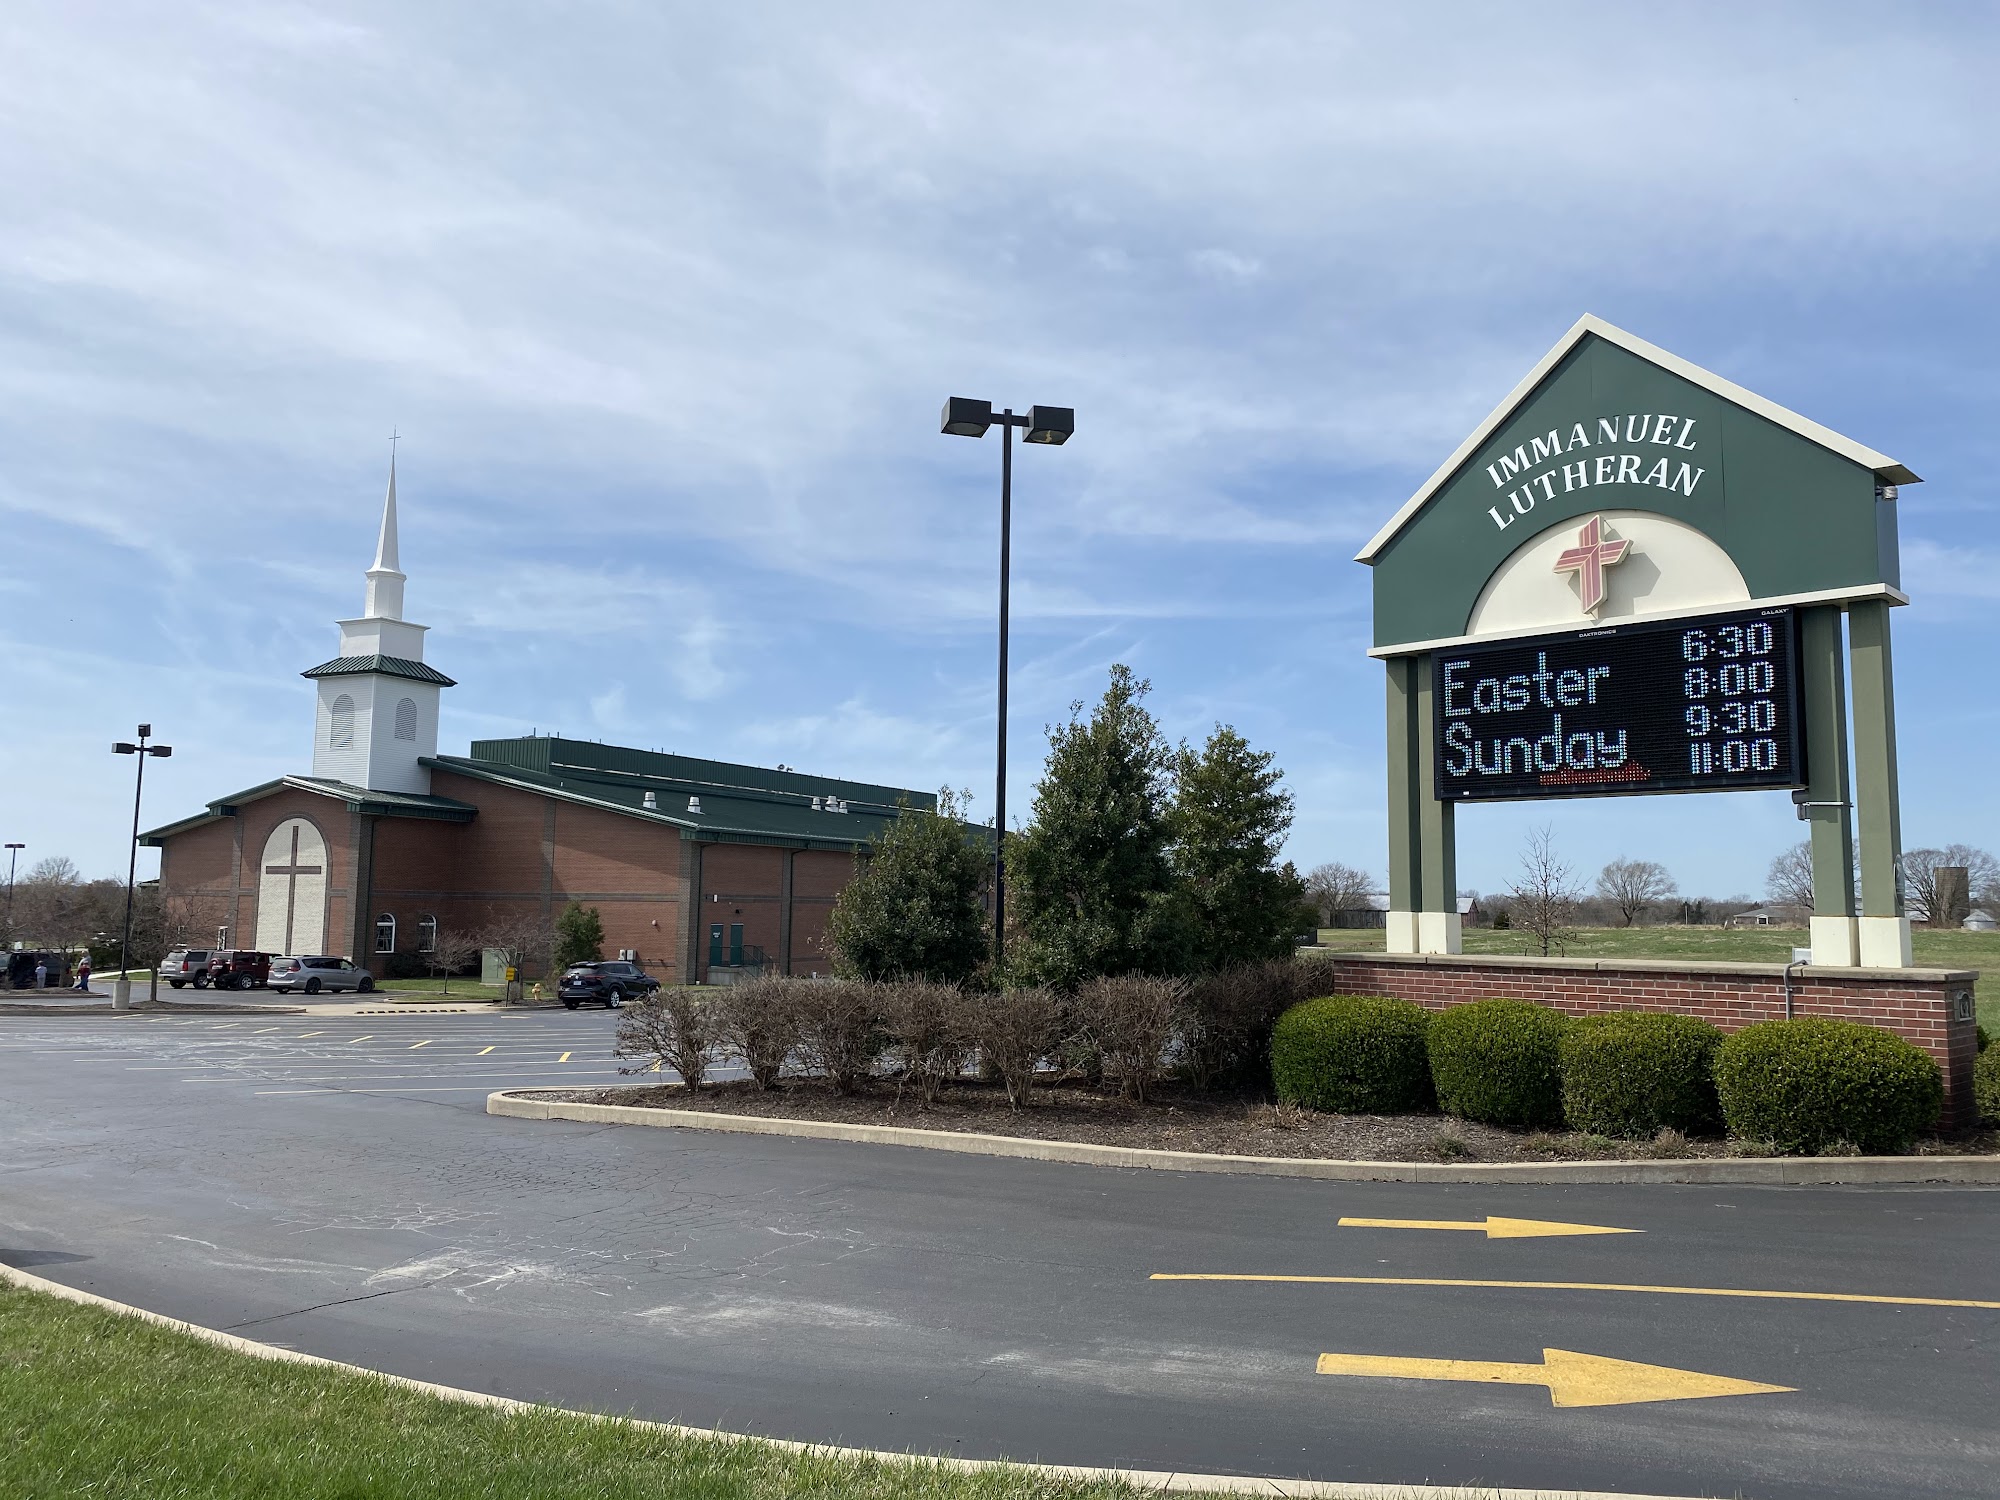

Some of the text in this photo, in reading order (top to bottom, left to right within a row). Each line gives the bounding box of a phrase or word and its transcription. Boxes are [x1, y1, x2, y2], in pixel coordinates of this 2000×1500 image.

[1486, 414, 1697, 490] IMMANUEL
[1487, 454, 1706, 531] LUTHERAN
[1761, 608, 1787, 616] GALAXY
[1578, 629, 1617, 638] DAKTRONICS
[1683, 622, 1773, 662] 6:30
[1444, 652, 1610, 717] Easter
[1684, 661, 1775, 699] 8:00
[1686, 700, 1776, 736] 9:30
[1446, 713, 1628, 777] Sunday
[1691, 738, 1778, 775] 11:00
